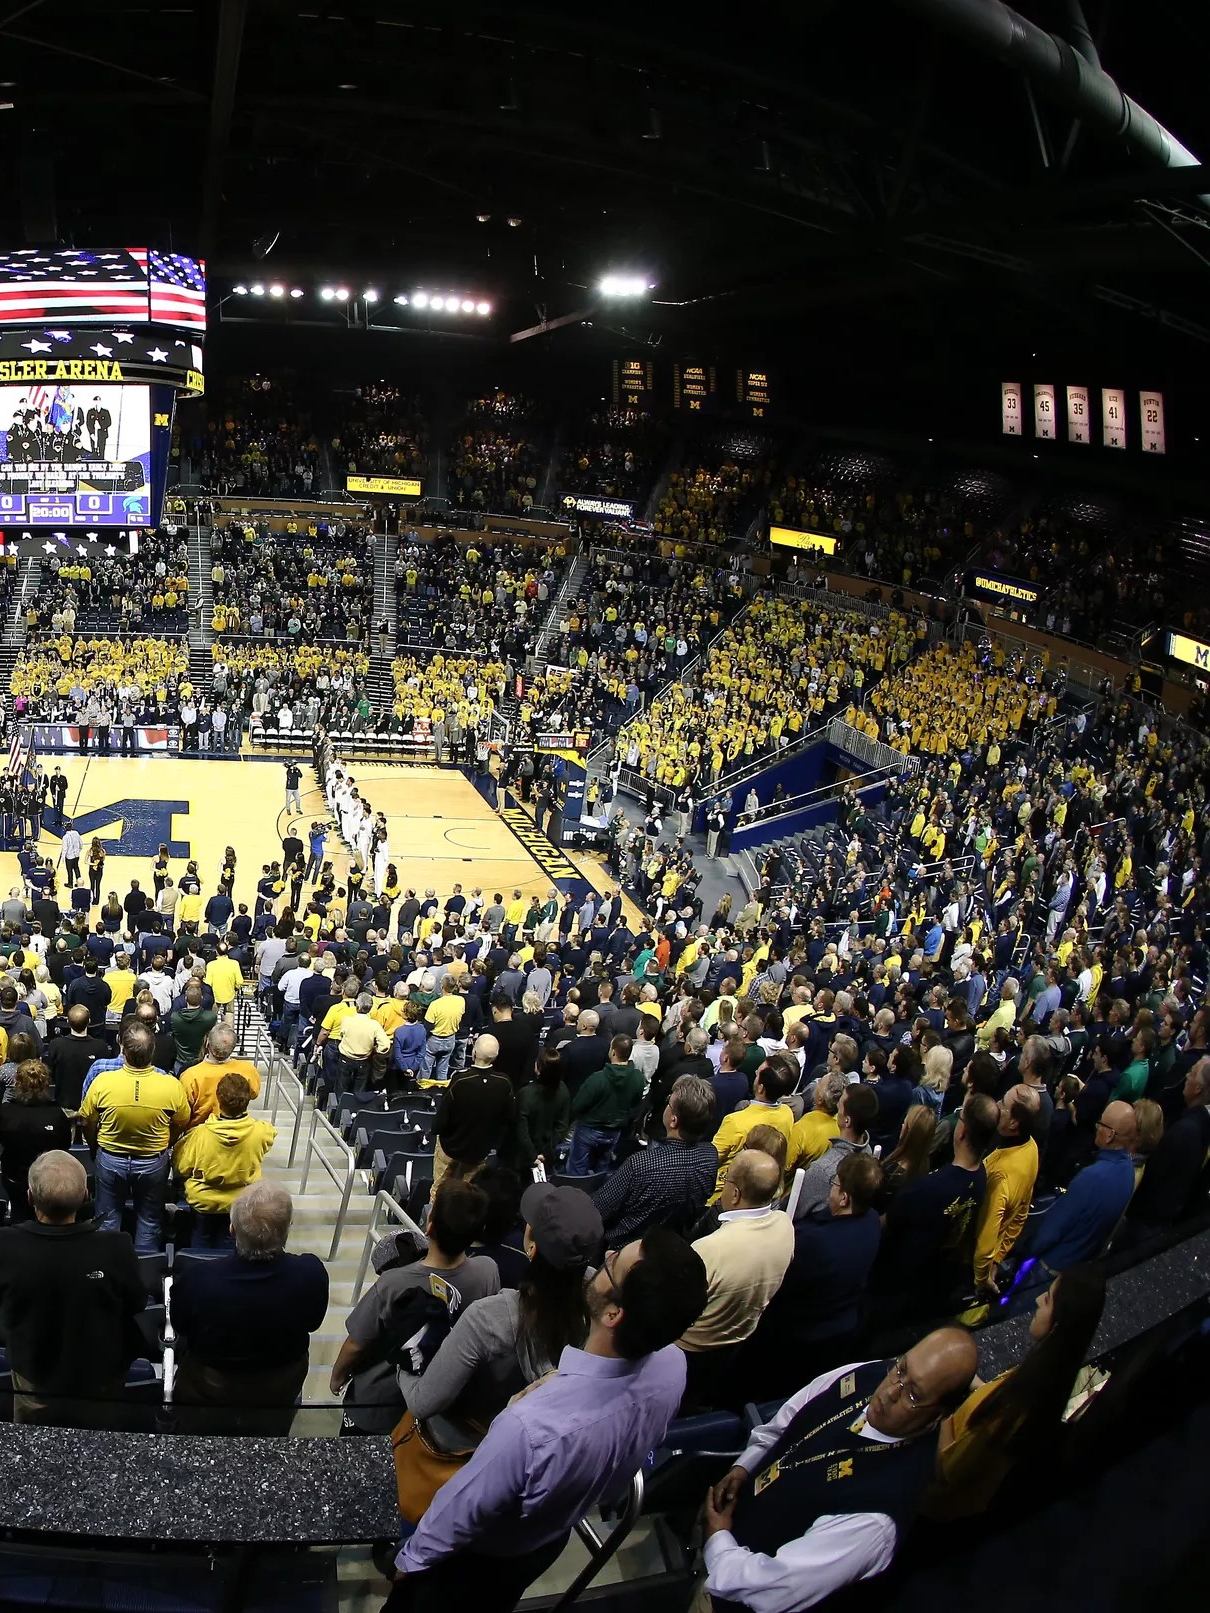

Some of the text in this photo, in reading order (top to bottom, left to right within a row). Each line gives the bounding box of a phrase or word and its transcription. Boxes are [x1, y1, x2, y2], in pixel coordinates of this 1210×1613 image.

[54, 360, 124, 381] ARENA
[749, 373, 767, 381] NCAA
[628, 395, 638, 403] M
[690, 401, 700, 409] M
[1007, 398, 1017, 409] 33
[752, 408, 764, 417] M
[1039, 401, 1050, 412] 45
[1073, 403, 1084, 415] 35
[1108, 407, 1118, 419] 41
[1147, 410, 1158, 422] 22
[154, 414, 169, 426] M
[348, 477, 381, 485] UNIVESITY
[1, 496, 13, 509] 0
[88, 496, 100, 509] 0
[577, 499, 602, 507] ALWAYS
[32, 507, 70, 518] 20:00
[577, 505, 604, 513] FOREVER
[976, 577, 1038, 602] @UMICHATHLETICS
[1195, 645, 1210, 668] M
[503, 808, 582, 879] MICHIGAN
[804, 1422, 827, 1440] MICHIGAN
[827, 1406, 854, 1424] ATHLETICS
[838, 1457, 854, 1479] M
